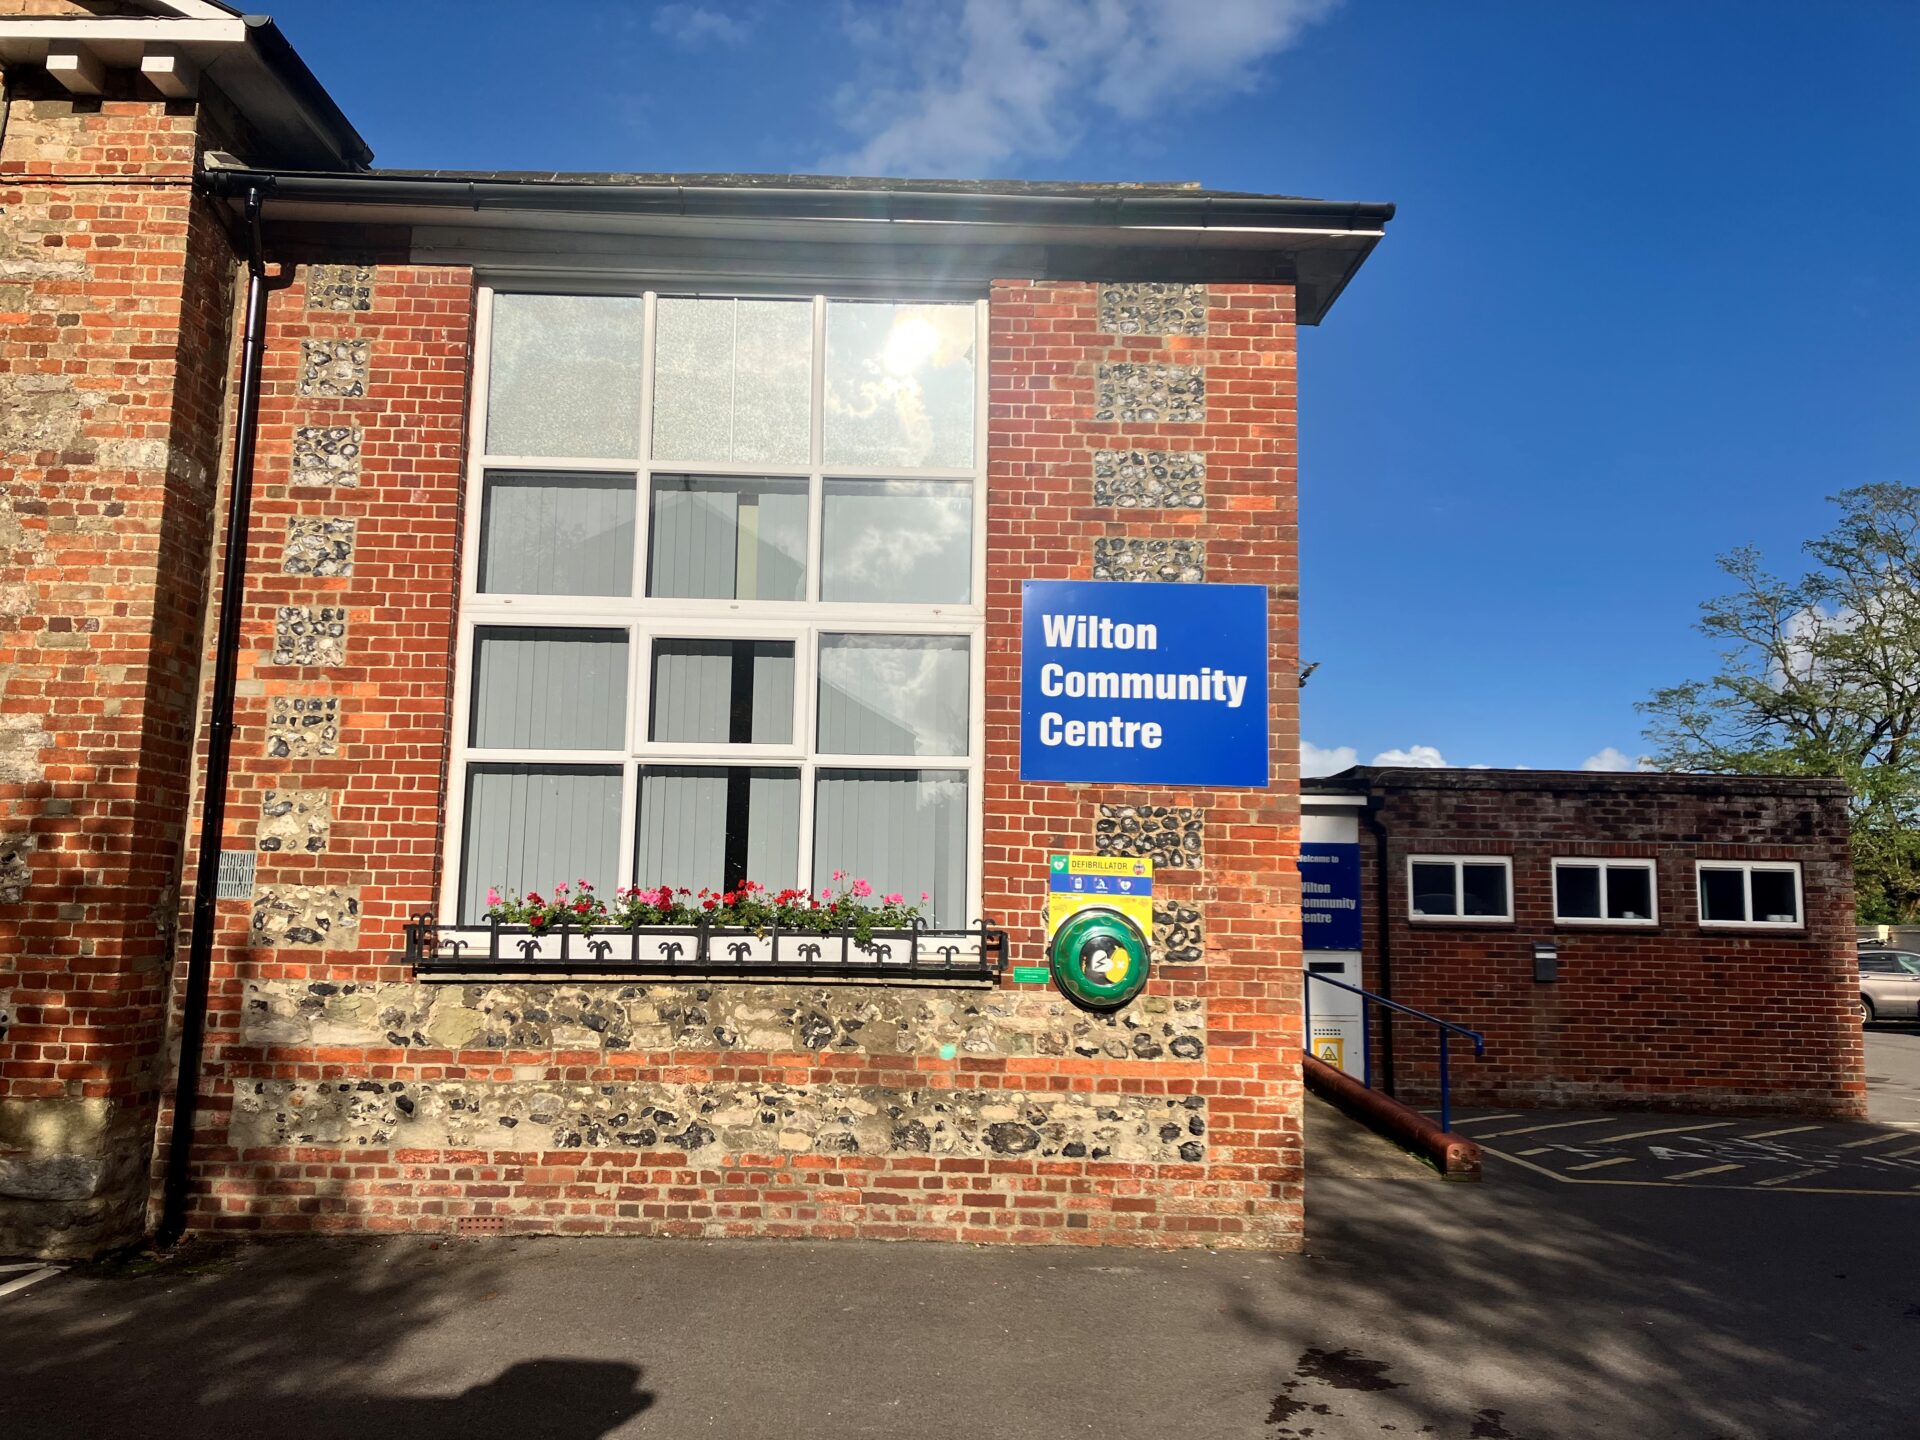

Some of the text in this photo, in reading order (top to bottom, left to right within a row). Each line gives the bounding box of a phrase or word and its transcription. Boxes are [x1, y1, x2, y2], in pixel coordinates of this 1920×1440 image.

[1042, 614, 1157, 650] Wilton
[1041, 663, 1248, 708] Community
[1040, 711, 1163, 749] Centre
[1071, 860, 1128, 870] DEFIBRILLATOR
[1331, 855, 1339, 863] to
[1302, 897, 1356, 910] ommunity
[1302, 912, 1332, 923] entre
